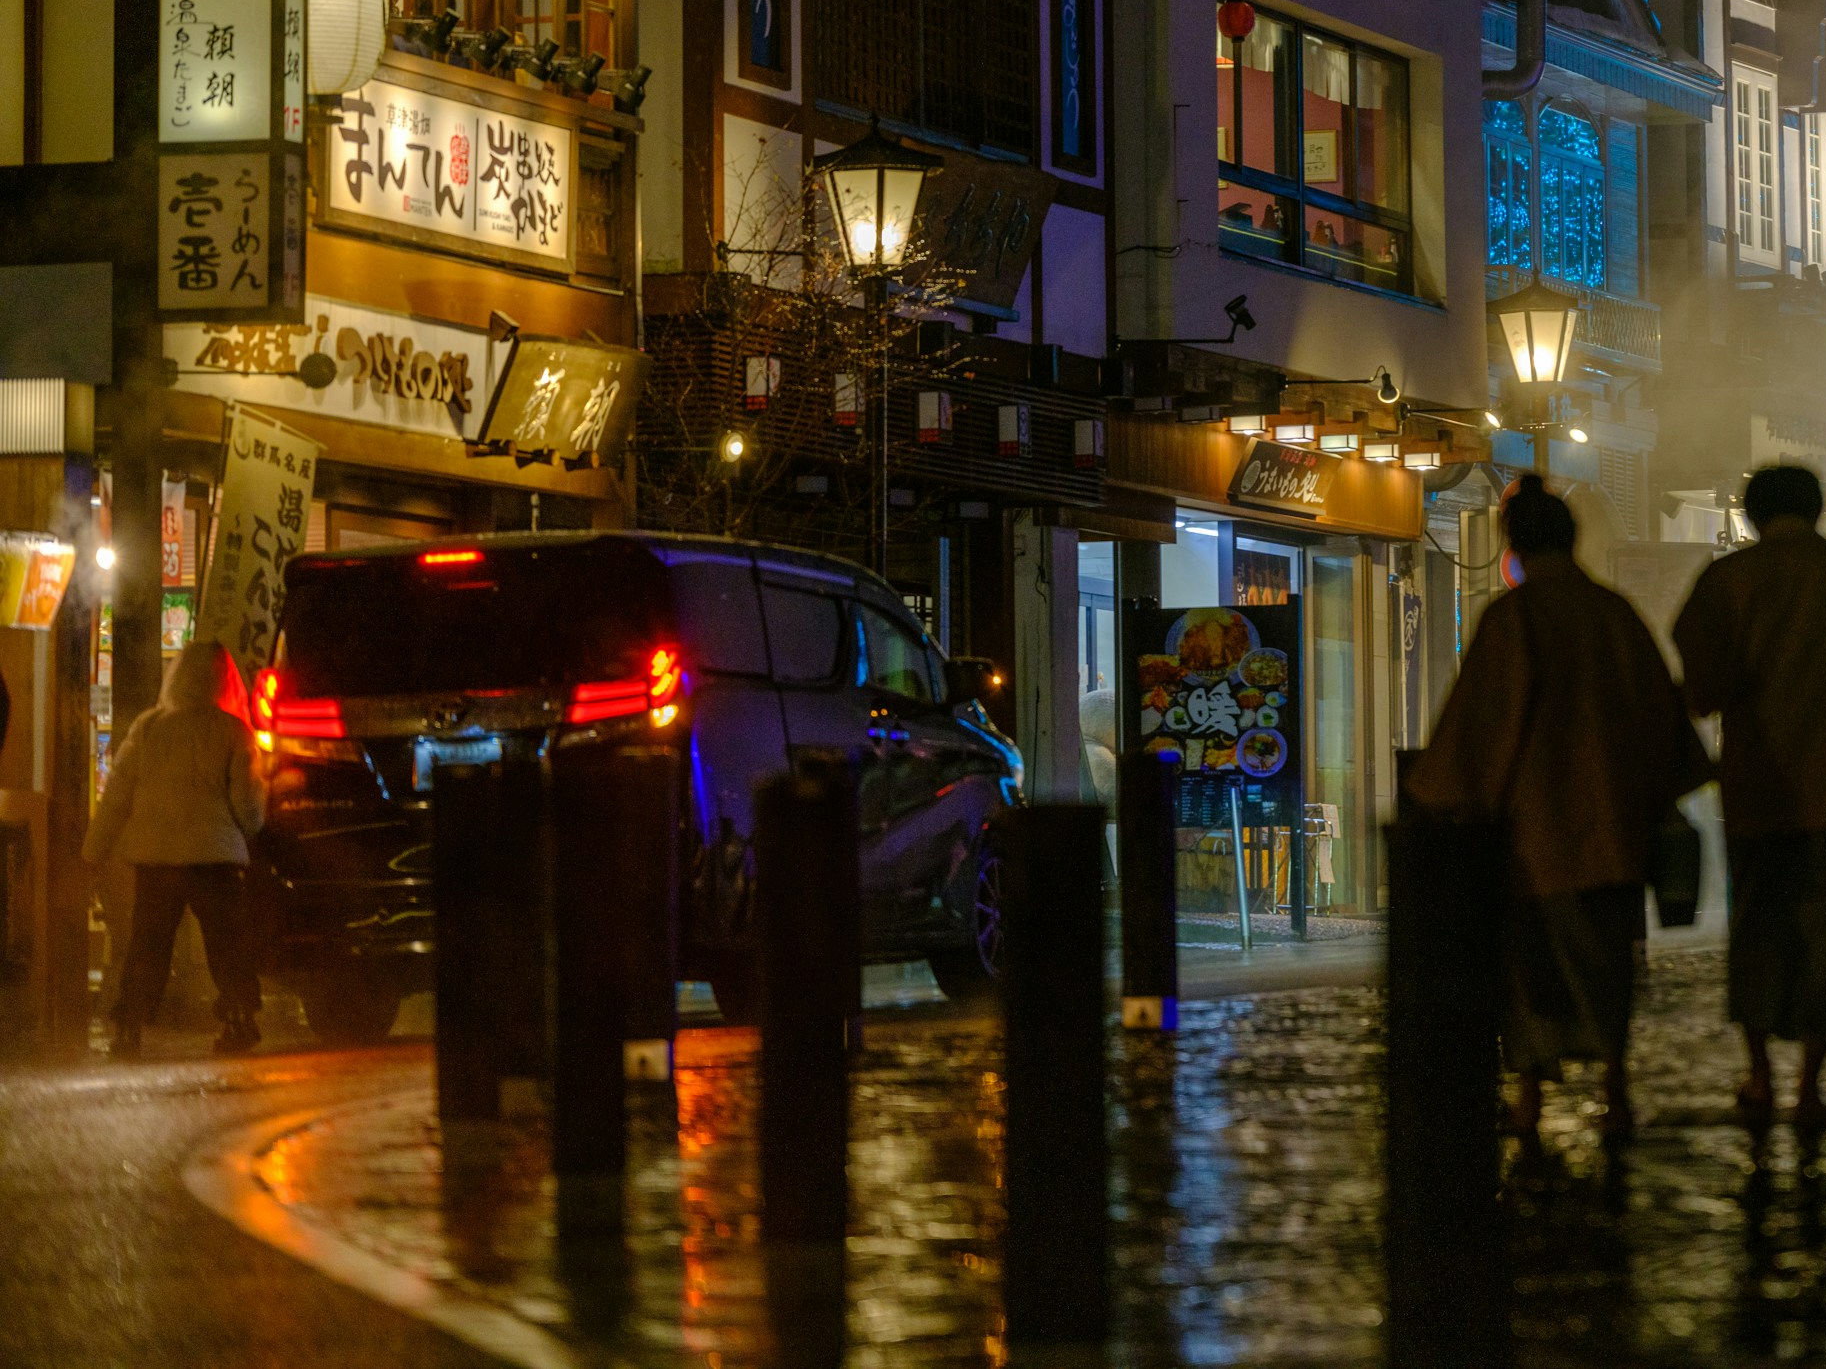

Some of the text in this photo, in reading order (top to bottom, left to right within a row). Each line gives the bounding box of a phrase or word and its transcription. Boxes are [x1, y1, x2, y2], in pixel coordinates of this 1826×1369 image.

[203, 25, 235, 108] 頼朝
[338, 87, 465, 219] まんてん
[169, 172, 223, 291] 壱番
[231, 168, 262, 291] らーめん
[511, 188, 563, 246] かまど
[253, 438, 311, 480] 群馬名産
[1188, 681, 1241, 738] 暖
